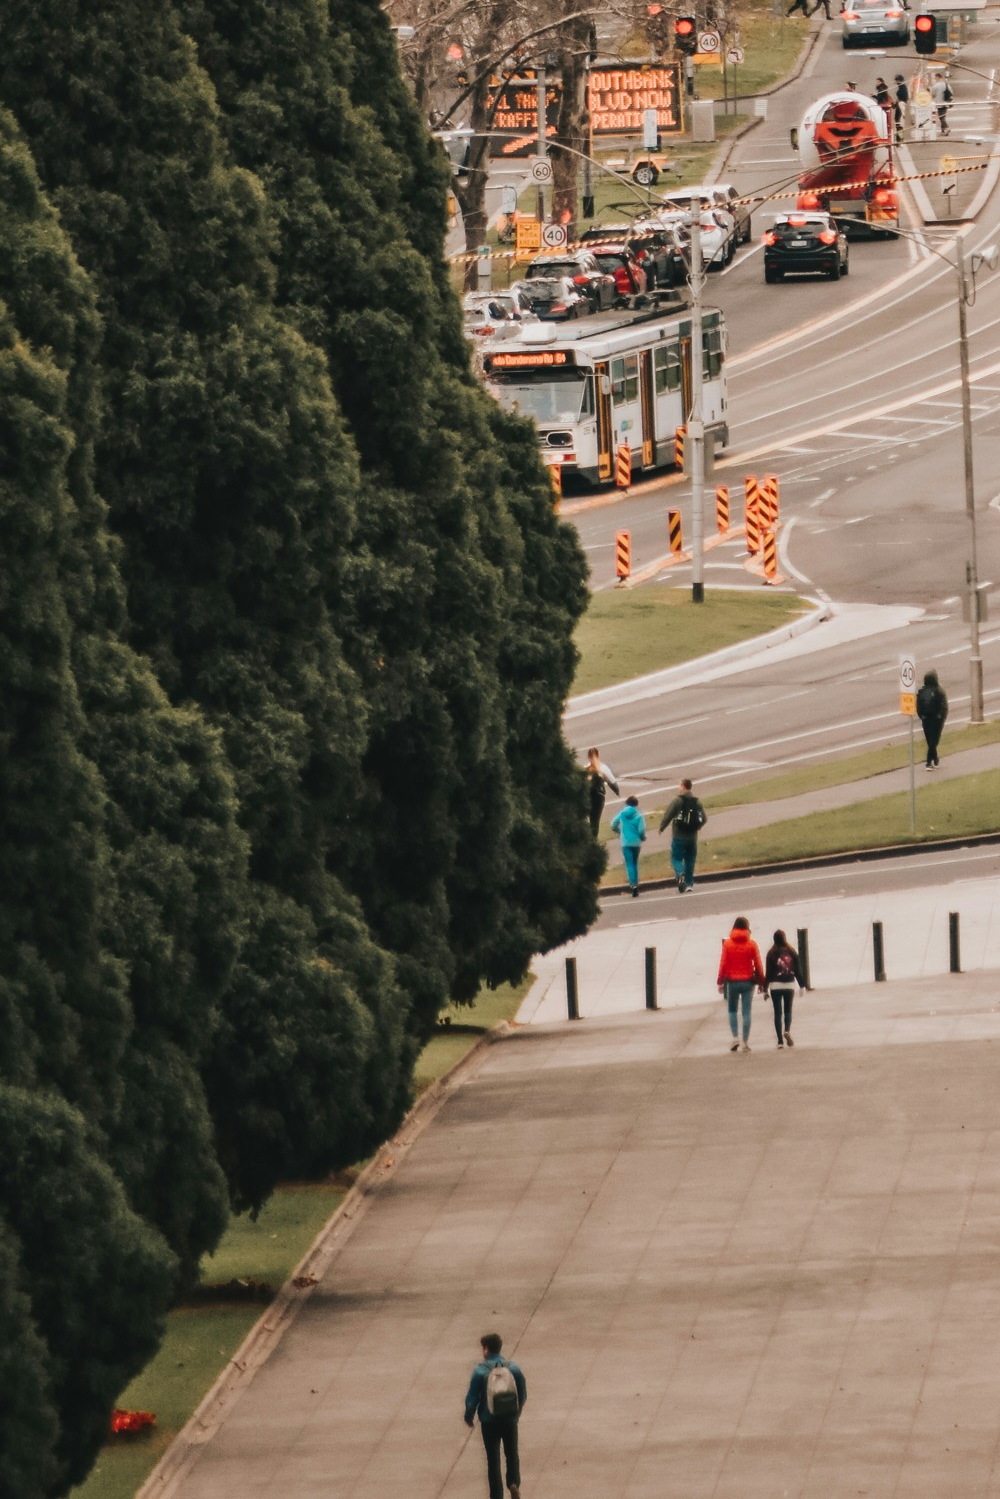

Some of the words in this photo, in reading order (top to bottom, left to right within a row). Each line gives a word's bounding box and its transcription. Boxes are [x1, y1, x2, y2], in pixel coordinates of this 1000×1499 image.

[703, 37, 716, 46] 40
[634, 90, 672, 109] NOW
[535, 166, 548, 177] 60
[546, 230, 563, 241] 40
[902, 667, 913, 681] 40
